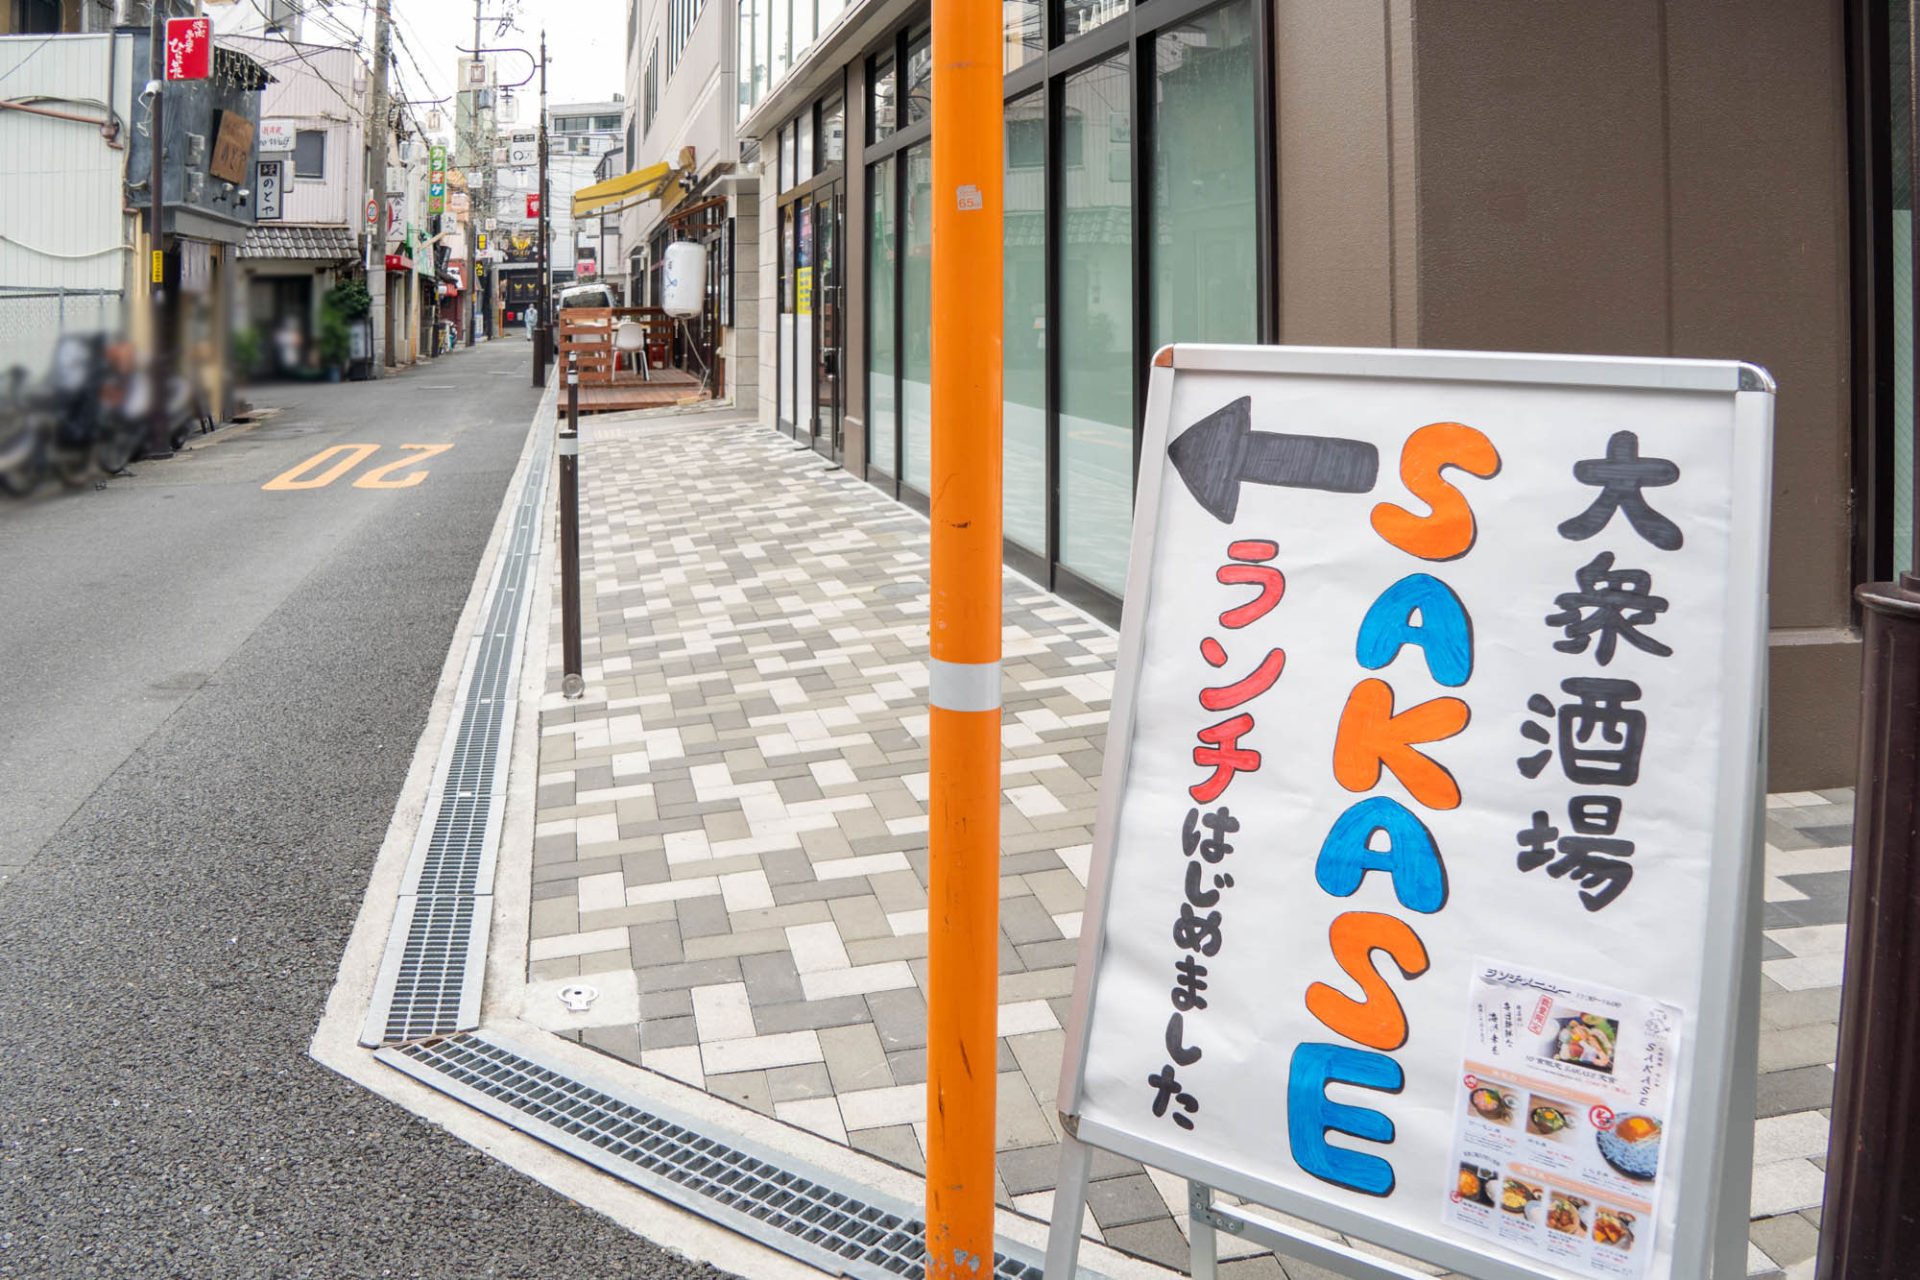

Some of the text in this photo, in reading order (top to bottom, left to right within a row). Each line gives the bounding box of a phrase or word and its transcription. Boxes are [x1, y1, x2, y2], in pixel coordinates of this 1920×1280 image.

[1516, 429, 1684, 911] 大衆酒場
[1287, 421, 1502, 1197] SAKASE
[1484, 968, 1571, 994] ランチメニュー
[1639, 1042, 1656, 1107] SAKASE
